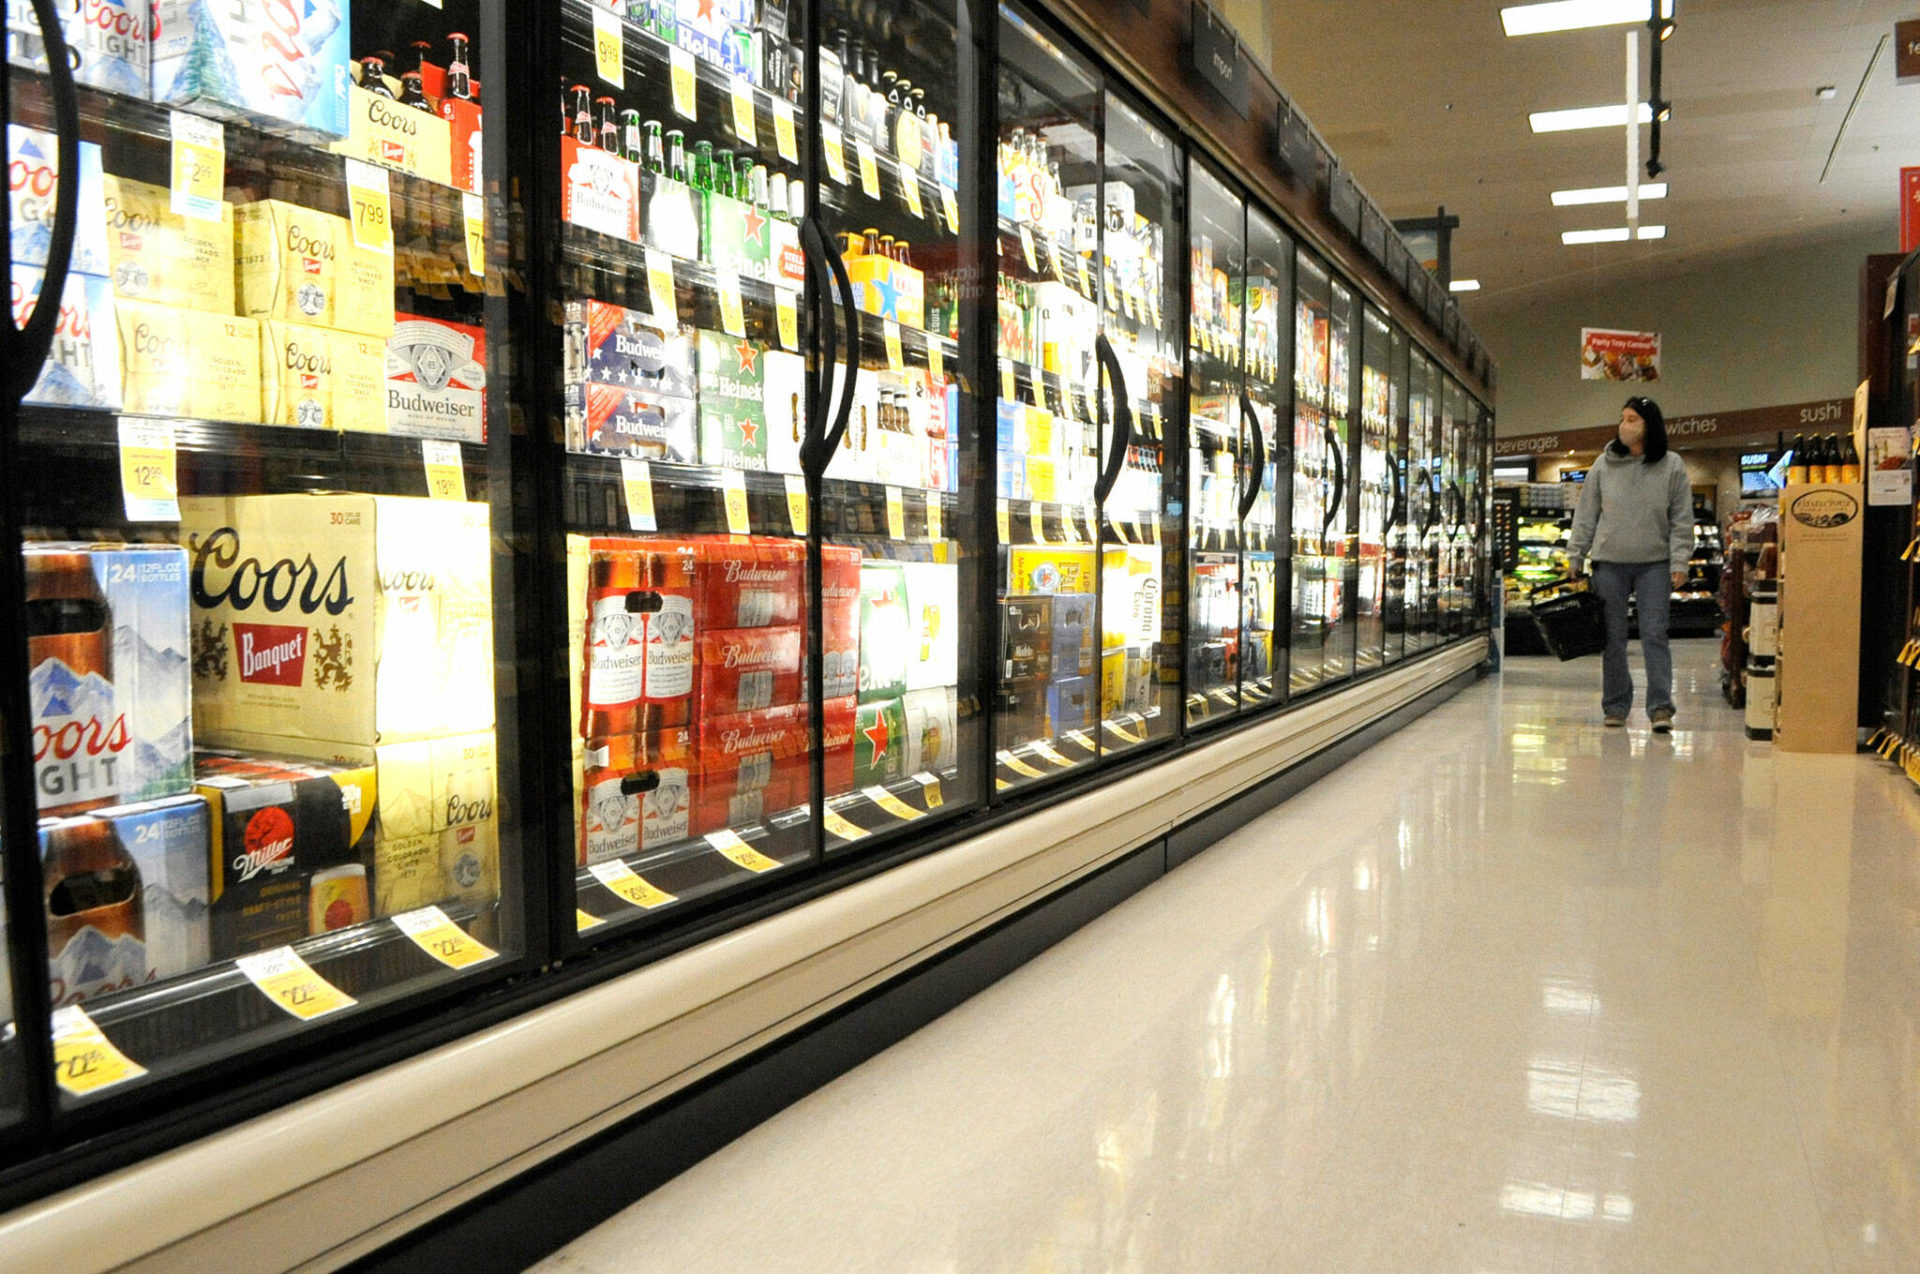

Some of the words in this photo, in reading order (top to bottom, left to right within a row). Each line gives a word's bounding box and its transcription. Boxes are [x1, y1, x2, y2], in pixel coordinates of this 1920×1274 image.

[368, 99, 417, 136] Coors
[287, 225, 335, 262] Coors
[286, 343, 332, 375] Coors
[388, 389, 475, 418] Budweiser
[1800, 401, 1842, 422] sushi
[1667, 417, 1717, 435] wiches
[1495, 435, 1559, 453] beverages
[330, 511, 344, 525] 30
[110, 564, 137, 583] 24
[190, 526, 354, 616] Coors
[682, 559, 694, 571] 24
[723, 559, 788, 583] Budweiser
[822, 581, 856, 598] udweiser
[242, 631, 303, 677] Banquet
[592, 653, 642, 670] Budweiser
[648, 649, 693, 666] Budweiser
[34, 713, 132, 763] oors
[678, 731, 688, 742] 24
[721, 728, 786, 754] Budweiser
[39, 757, 118, 796] GHT
[447, 794, 492, 826] Coors
[135, 822, 160, 844] 24
[643, 820, 688, 840] Budweiser
[588, 833, 637, 855] Budweiser
[232, 837, 293, 883] Miller
